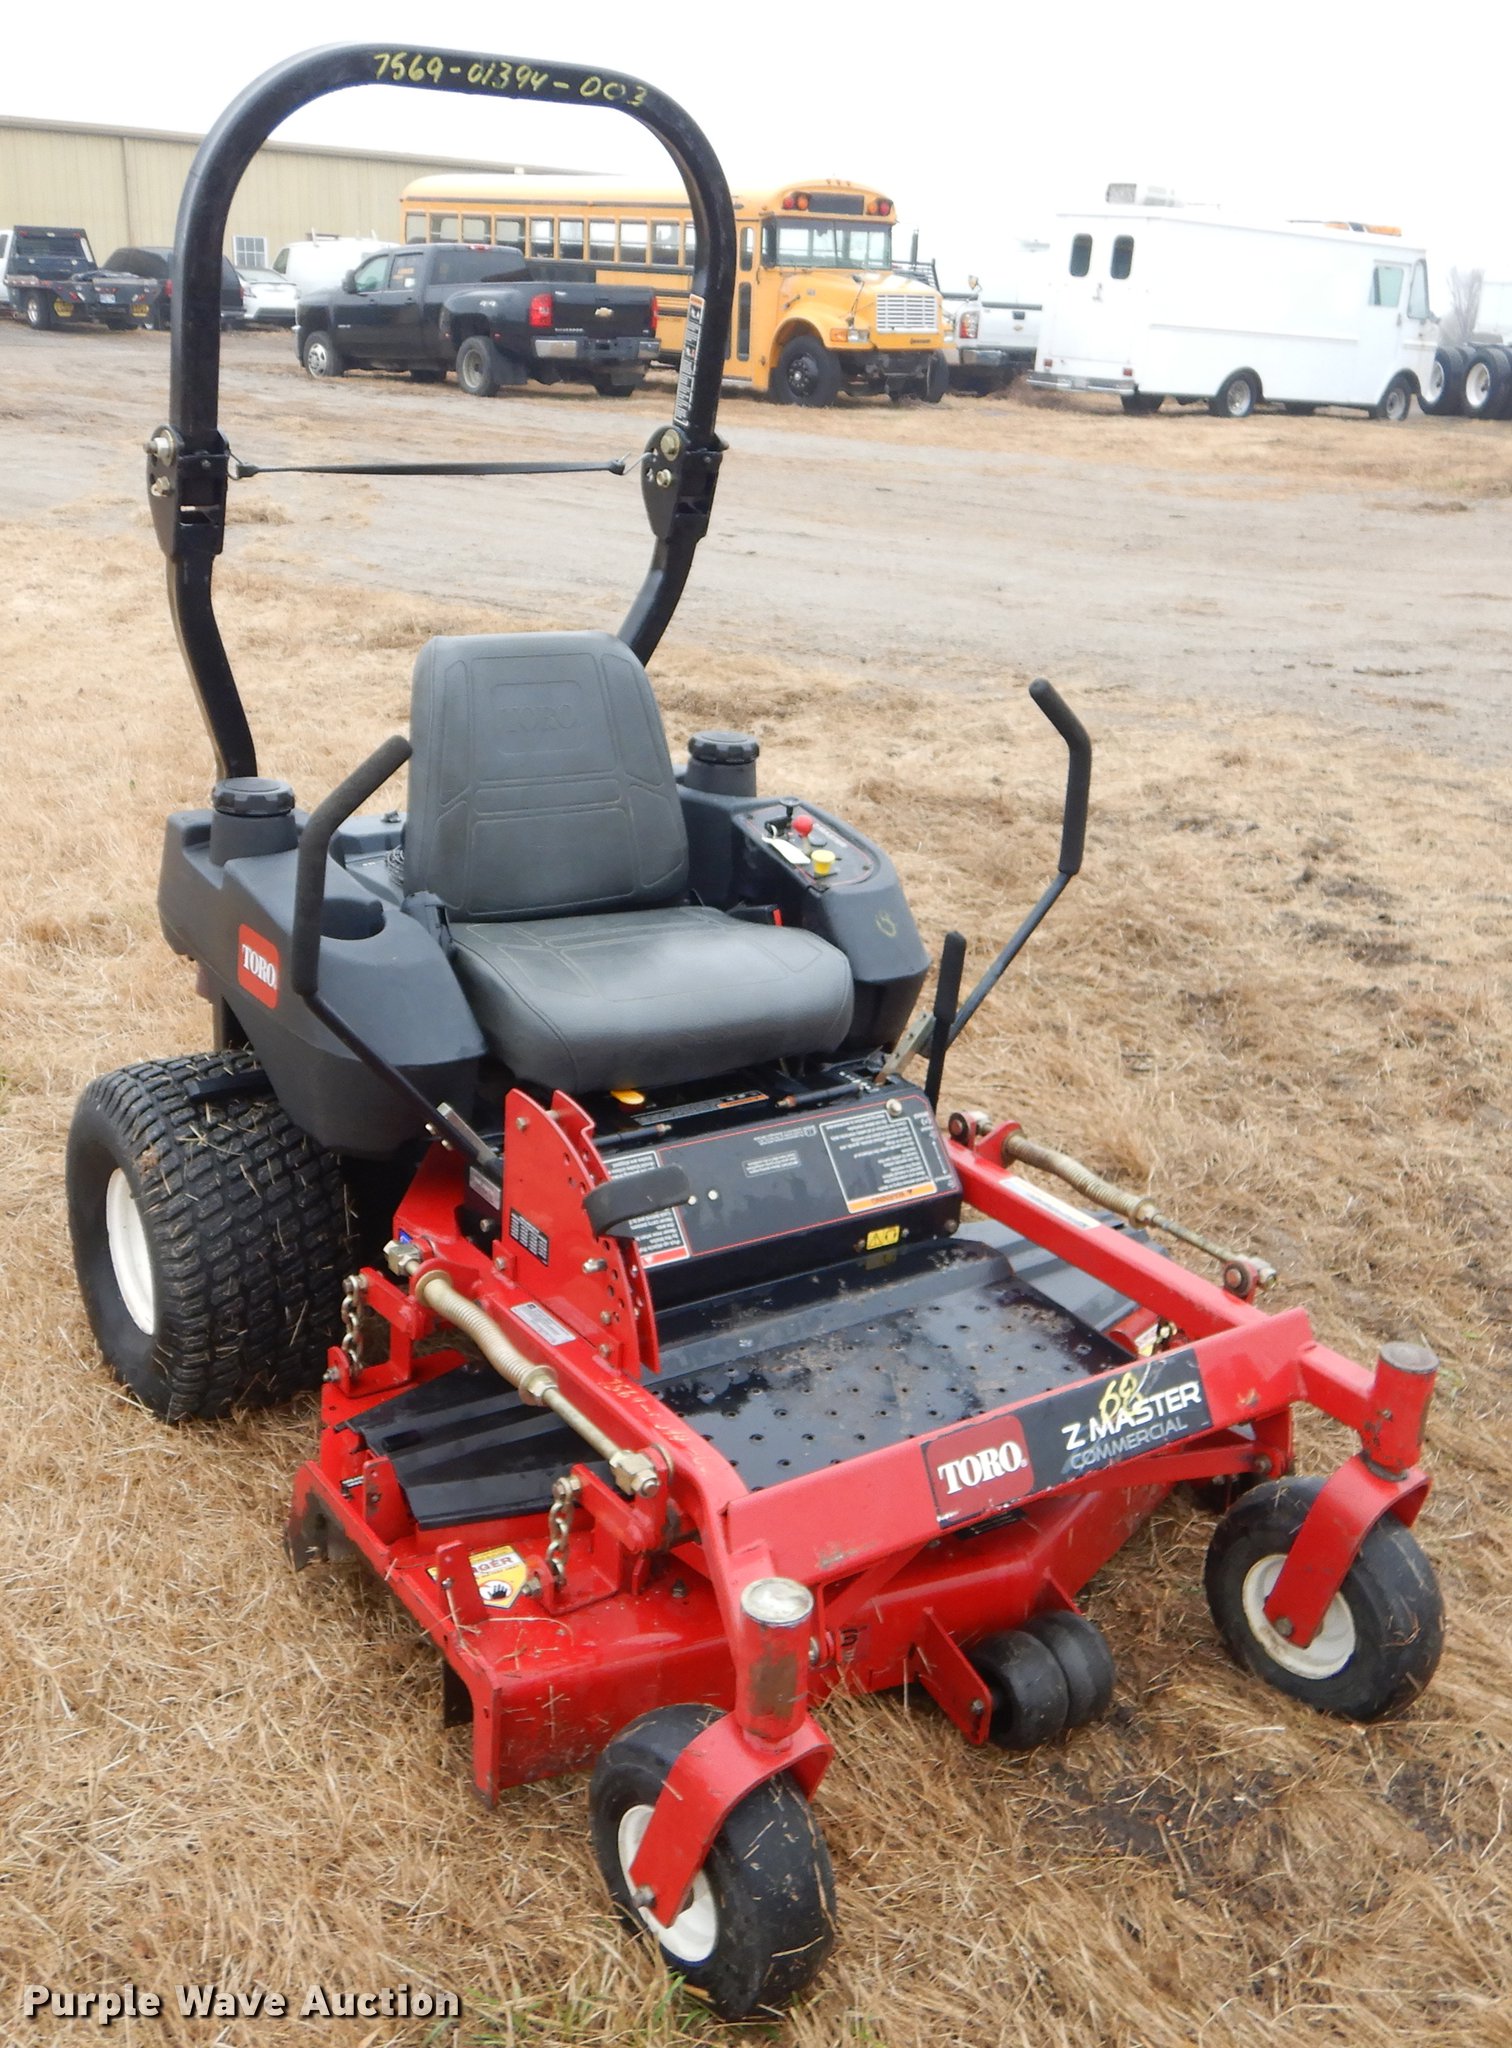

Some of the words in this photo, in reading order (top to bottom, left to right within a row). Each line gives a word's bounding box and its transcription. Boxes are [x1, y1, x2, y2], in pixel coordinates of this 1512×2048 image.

[374, 51, 647, 107] 7569-01394-003
[242, 944, 277, 989] TORO
[1061, 1422, 1087, 1450] Z
[1089, 1380, 1202, 1442] MASTER
[937, 1441, 1023, 1494] TORO
[1070, 1416, 1188, 1469] COMMERCIAL
